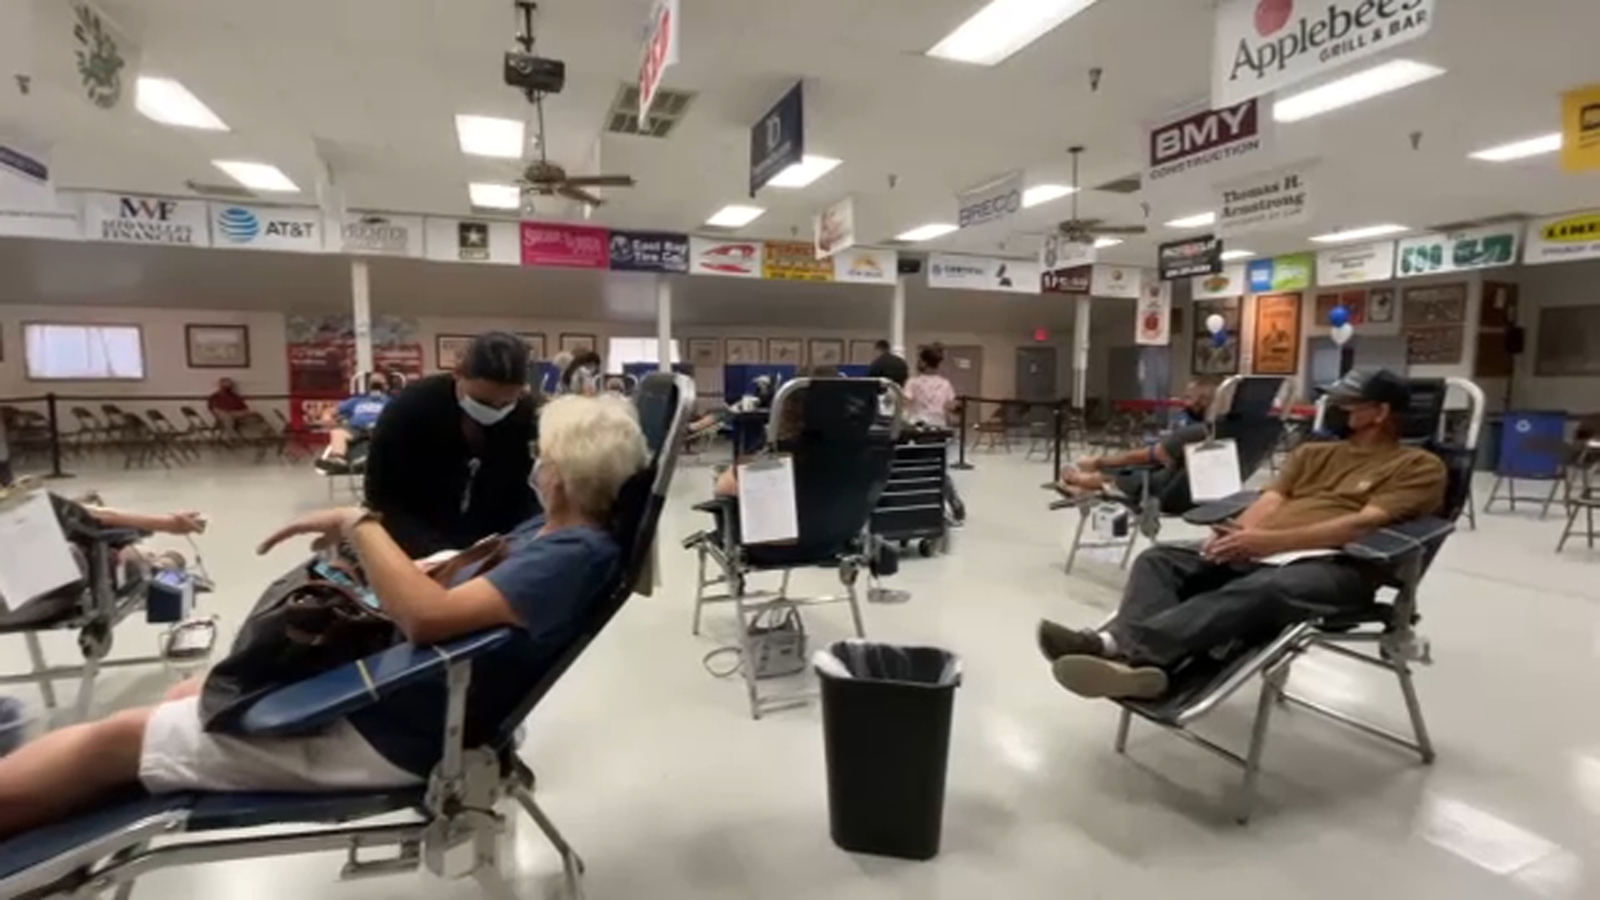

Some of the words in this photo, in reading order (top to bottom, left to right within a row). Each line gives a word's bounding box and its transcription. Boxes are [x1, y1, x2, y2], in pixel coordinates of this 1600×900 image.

[1229, 0, 1422, 80] Applebees
[1319, 37, 1367, 63] GRILL
[1371, 29, 1383, 43] &
[1388, 10, 1428, 36] BAR
[1155, 103, 1247, 160] BMY
[1149, 139, 1260, 181] CONSTRUCTION
[1221, 192, 1306, 218] Armstrong
[1222, 181, 1280, 204] Thomas
[1284, 174, 1304, 190] H.
[265, 220, 315, 238] AT&T
